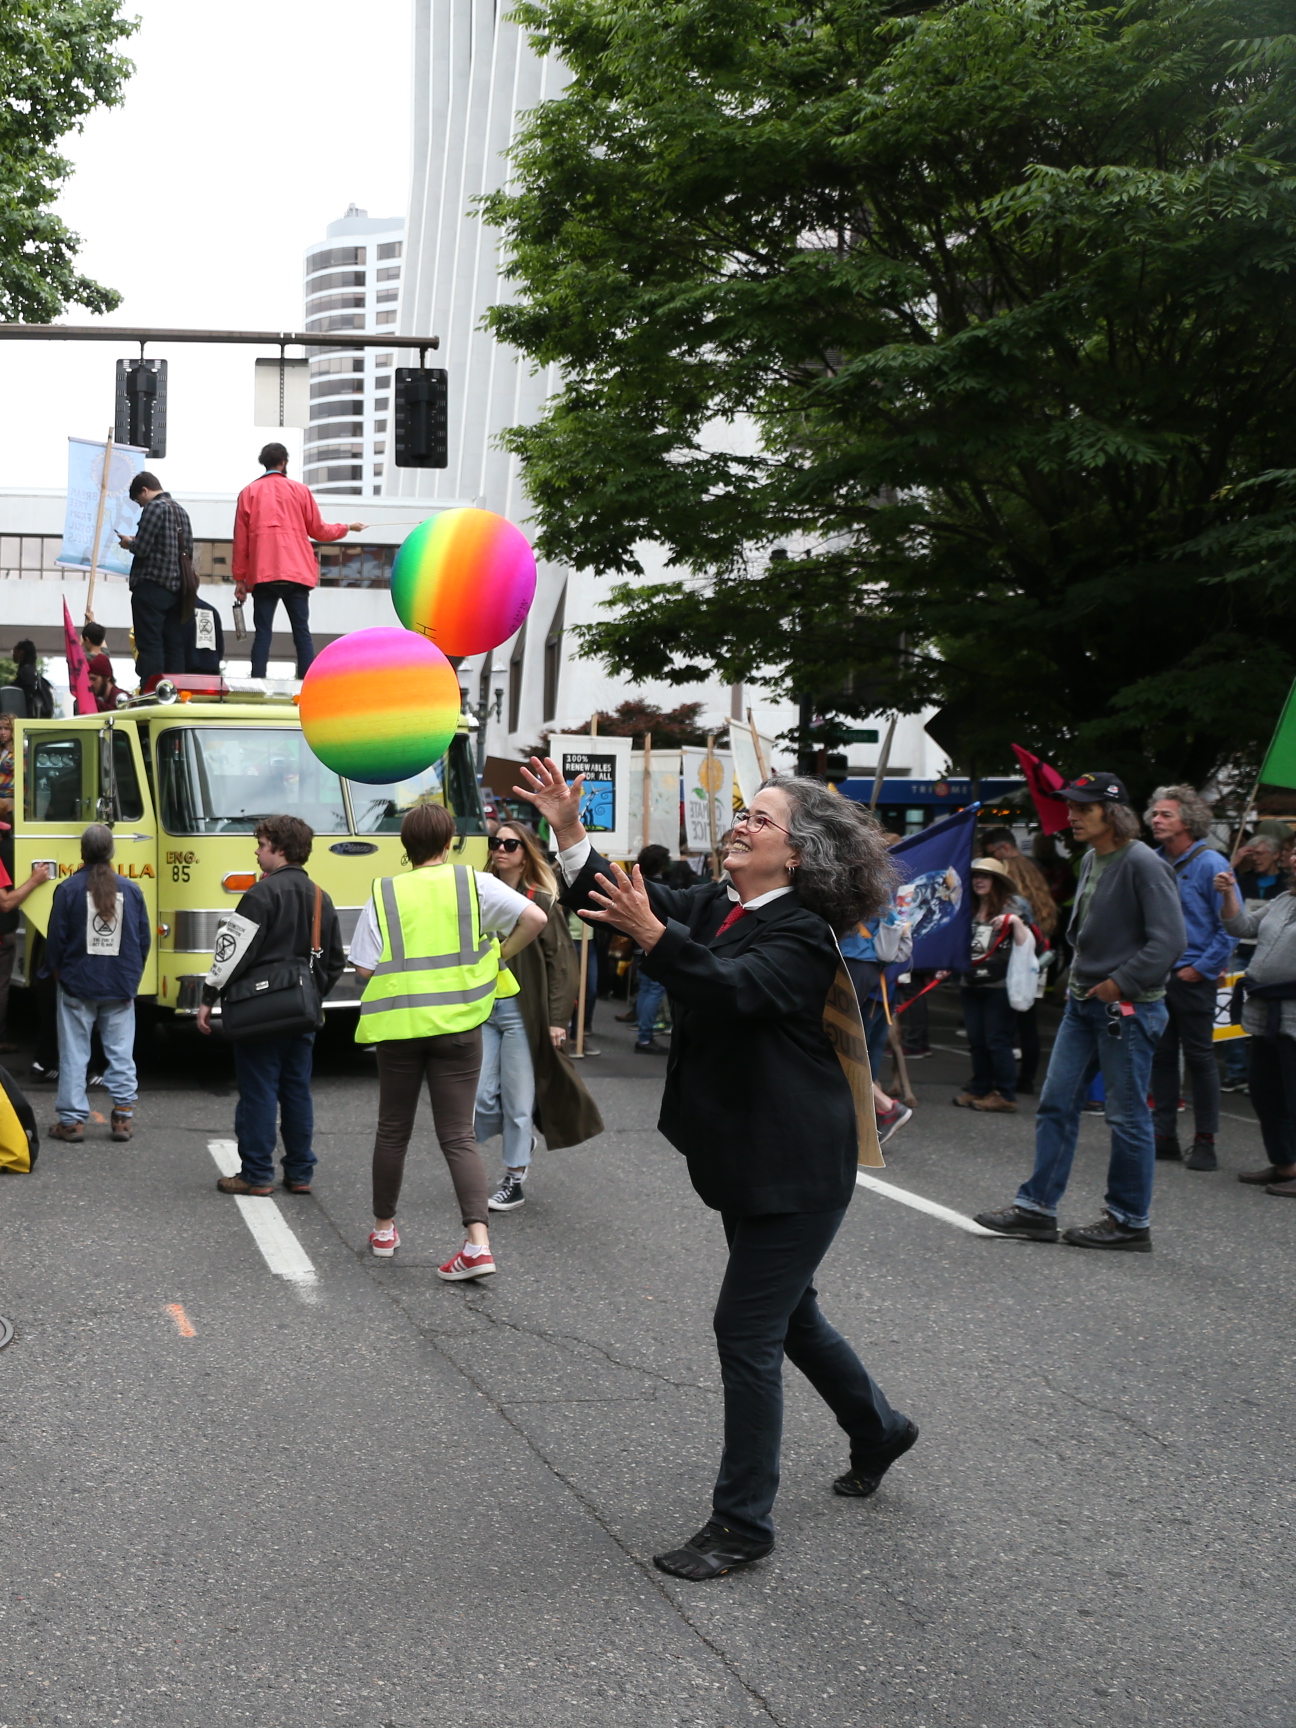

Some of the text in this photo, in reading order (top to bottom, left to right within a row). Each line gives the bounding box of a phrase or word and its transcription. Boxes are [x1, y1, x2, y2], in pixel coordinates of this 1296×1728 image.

[565, 763, 612, 772] RENEWABLES
[598, 773, 613, 781] ALL
[166, 851, 200, 865] ENG.
[58, 863, 155, 878] MLLA
[172, 865, 191, 882] 85
